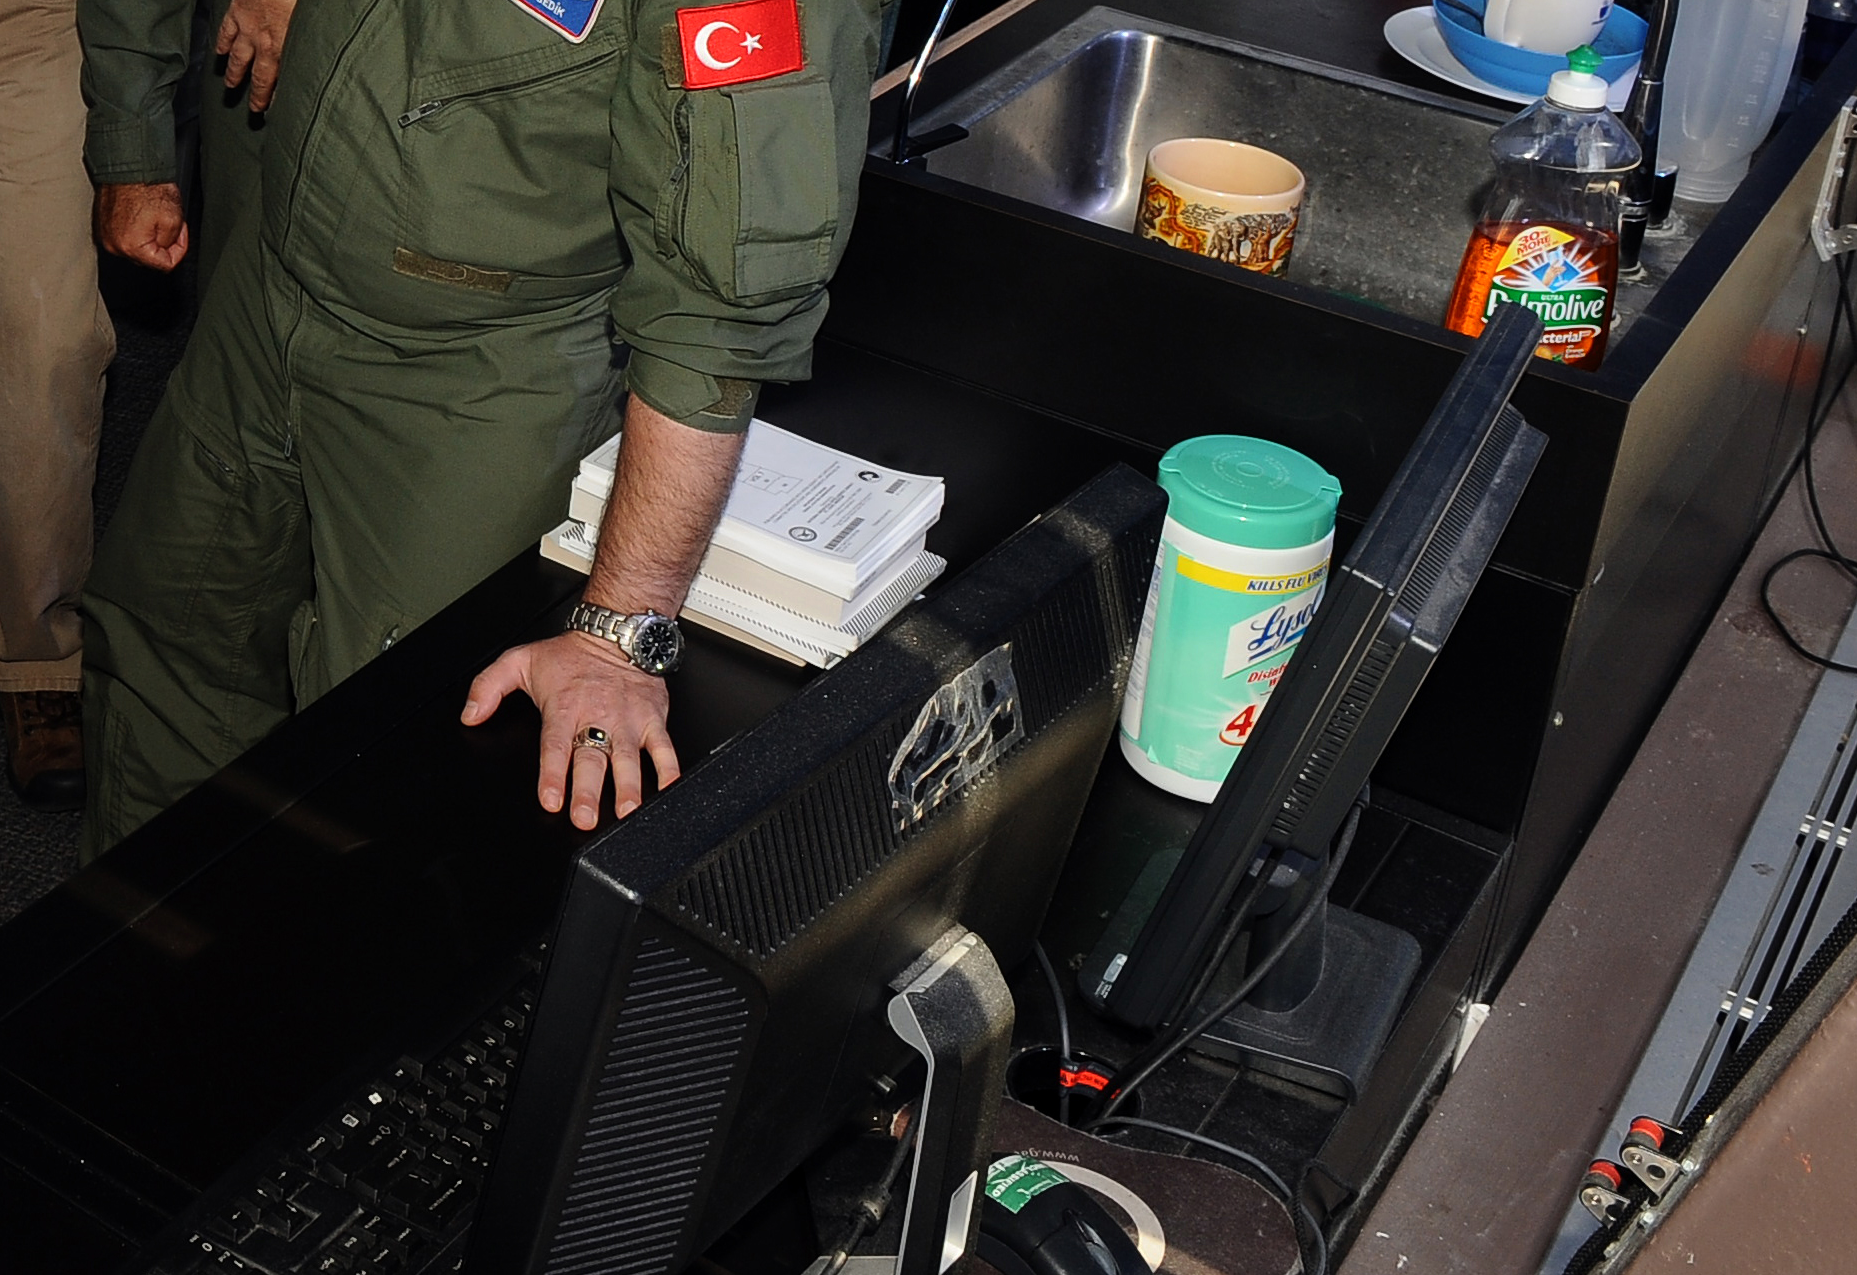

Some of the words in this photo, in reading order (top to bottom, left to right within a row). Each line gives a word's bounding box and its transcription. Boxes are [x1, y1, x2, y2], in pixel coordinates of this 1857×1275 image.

[1516, 236, 1551, 255] MORE
[1487, 288, 1605, 322] Plmolive
[1247, 577, 1284, 594] KILLS
[1284, 575, 1305, 591] FLU
[464, 1053, 477, 1065] M
[483, 1076, 496, 1087] K
